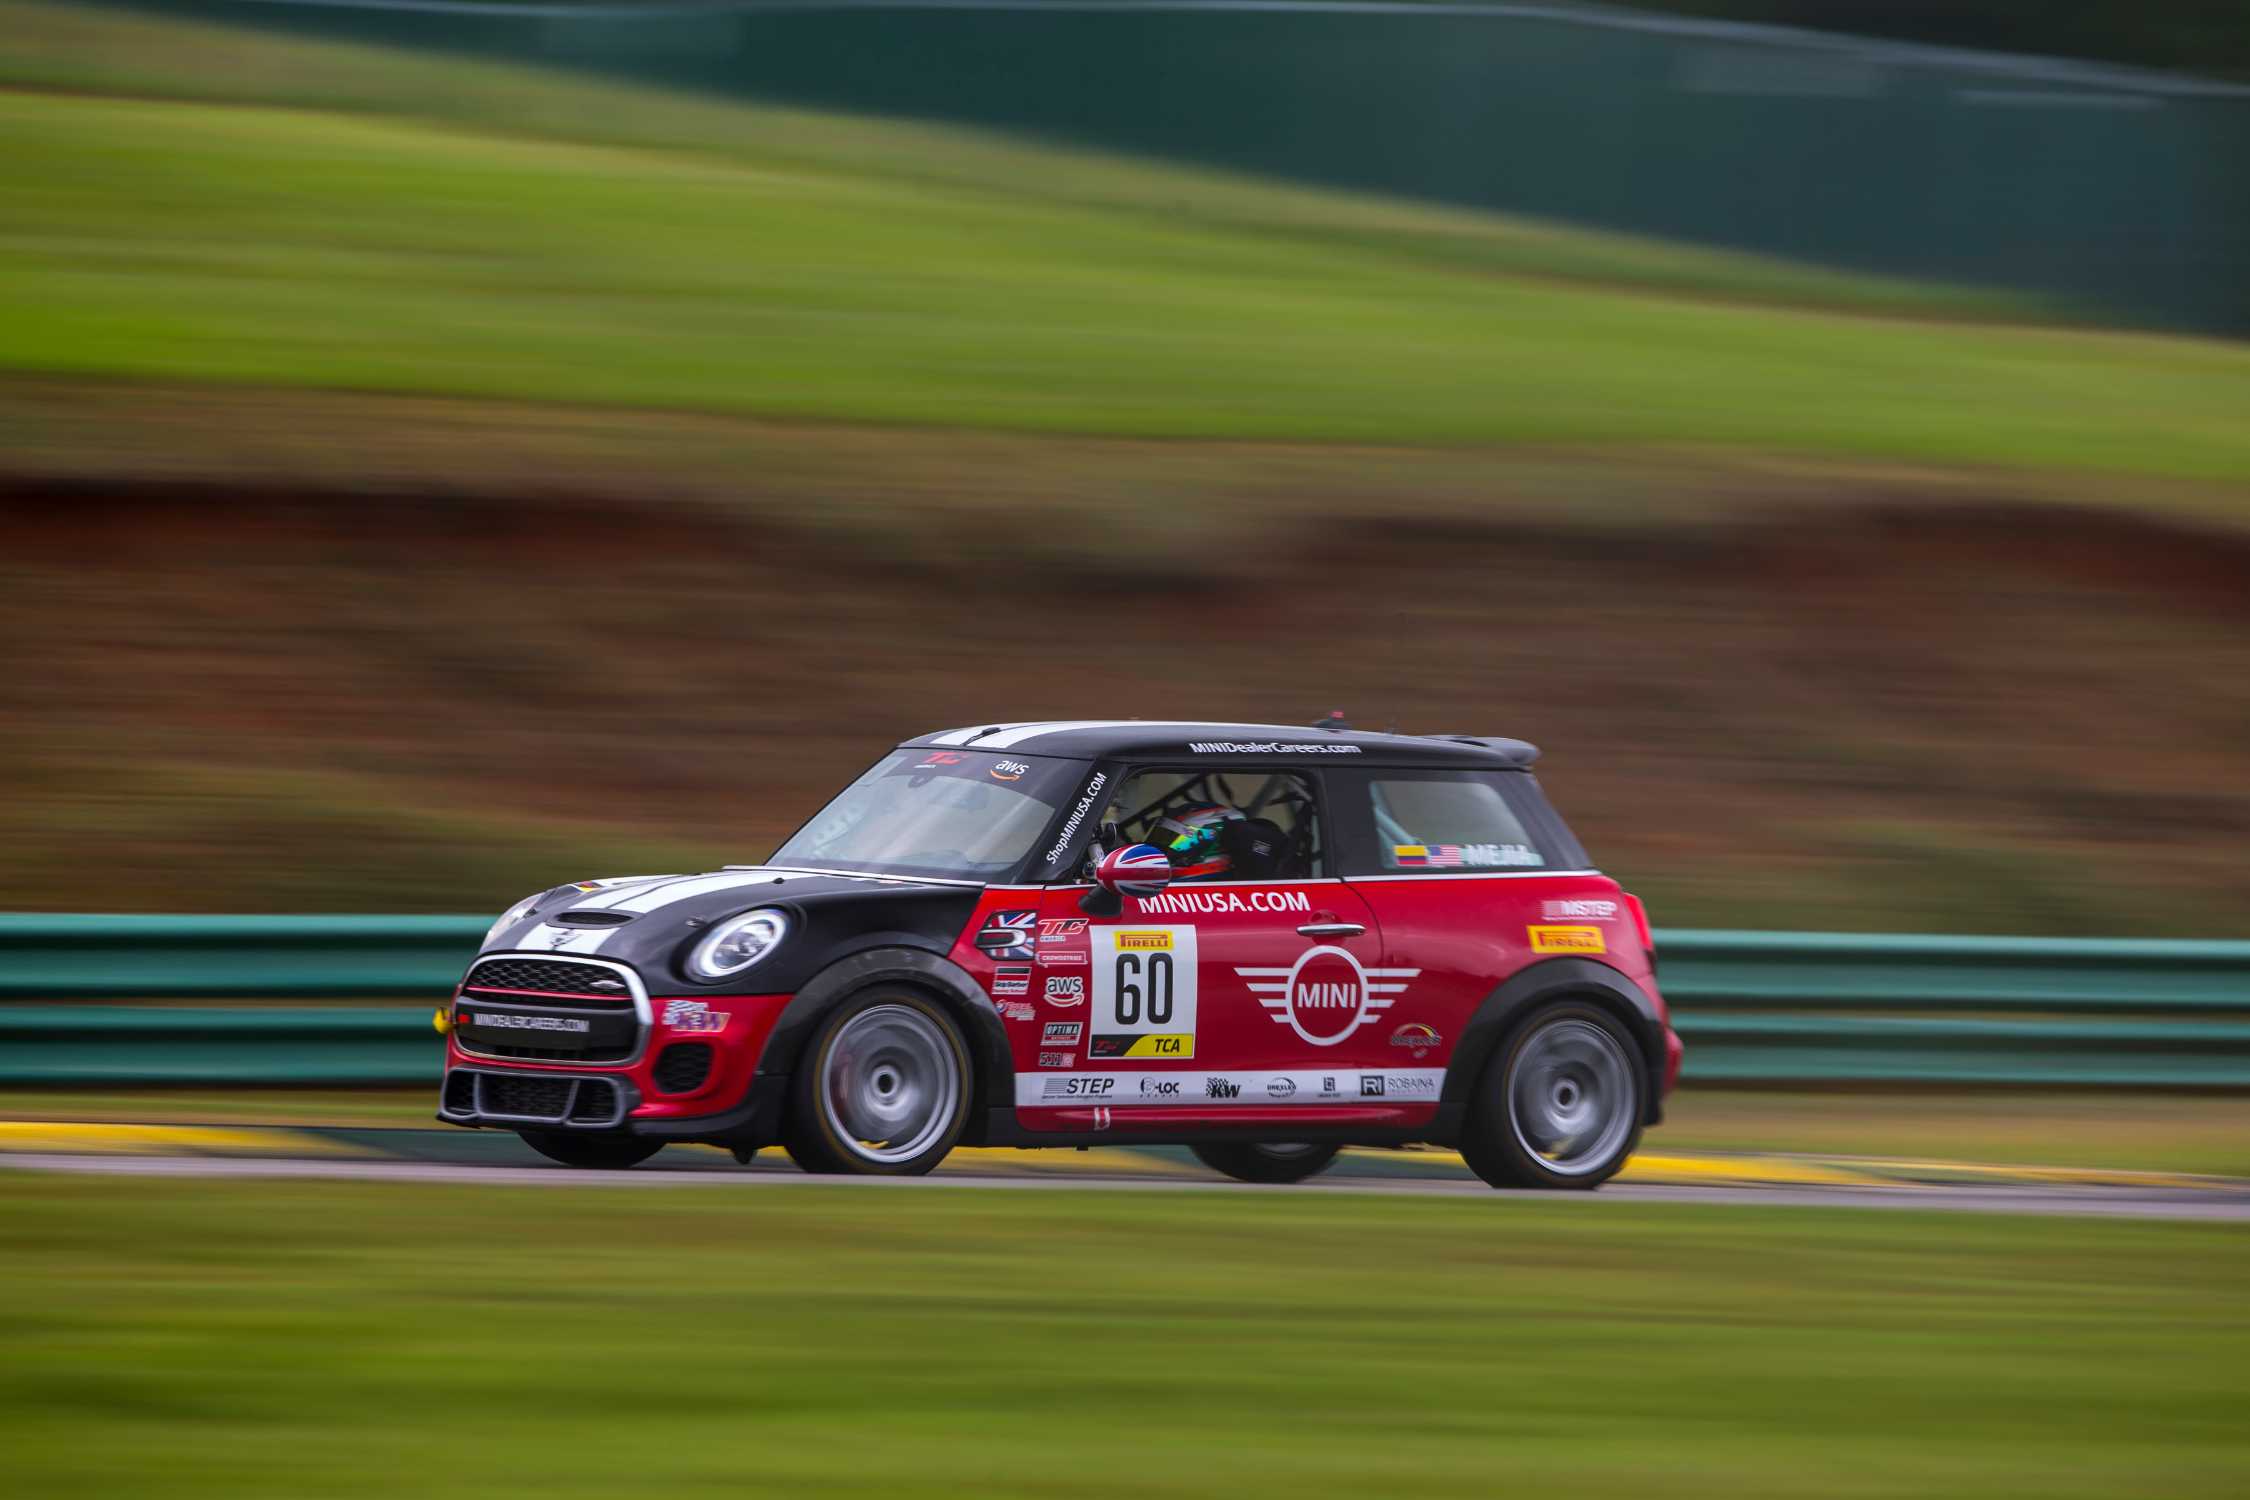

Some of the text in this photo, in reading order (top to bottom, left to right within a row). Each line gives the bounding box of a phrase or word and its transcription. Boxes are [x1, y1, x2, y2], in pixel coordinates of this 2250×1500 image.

[1189, 742, 1362, 753] MINIDealerCareers.com
[995, 760, 1030, 775] aws
[1046, 772, 1108, 865] ShopMINIUSA.COM
[1138, 892, 1312, 913] MINIUSA.COM
[1120, 934, 1168, 948] PIRELLI
[1047, 978, 1082, 993] aws
[1115, 953, 1174, 1026] 60
[1298, 983, 1357, 1009] MINI
[1047, 1025, 1079, 1036] OPTIMA
[1155, 1039, 1181, 1053] TCA
[1066, 1078, 1115, 1094] STEP
